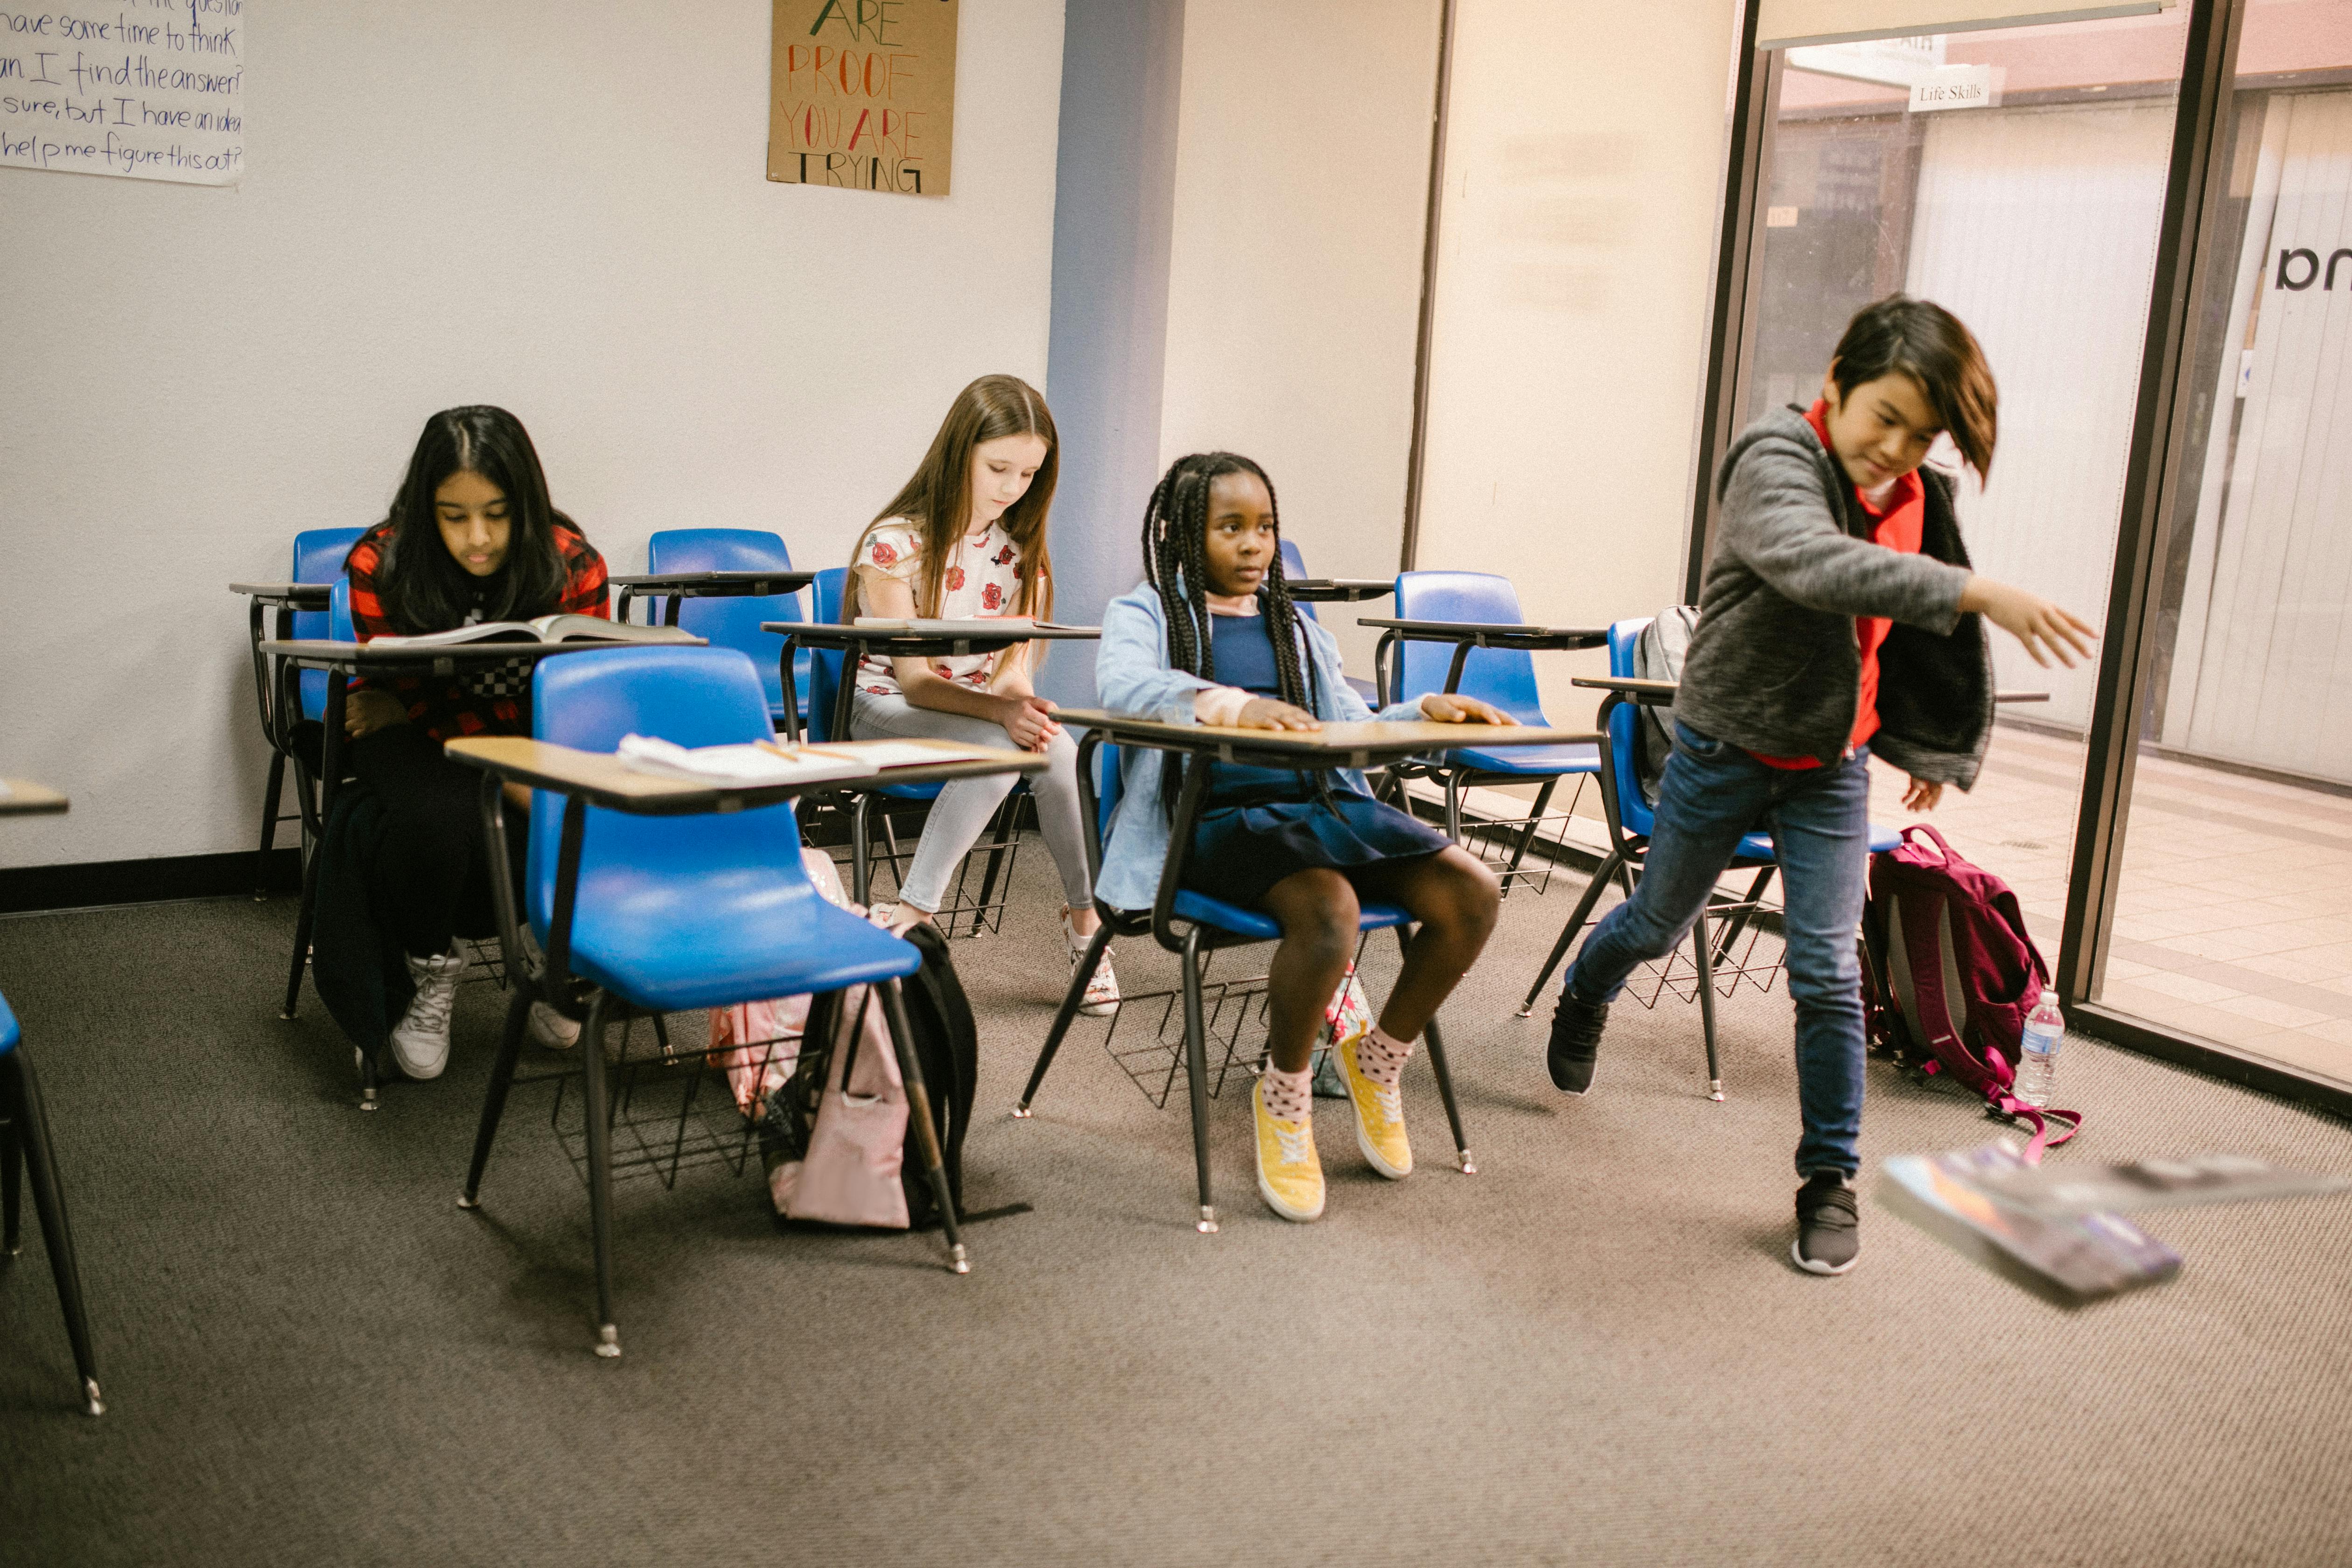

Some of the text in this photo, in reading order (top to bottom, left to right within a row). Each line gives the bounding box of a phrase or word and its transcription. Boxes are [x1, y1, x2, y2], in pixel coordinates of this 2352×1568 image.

[60, 16, 111, 40] some
[114, 13, 159, 45] time
[167, 22, 184, 51] to
[809, 0, 904, 46] ARE
[30, 53, 61, 85] I
[69, 51, 131, 96] find
[134, 55, 168, 89] the
[788, 44, 919, 100] PROOF
[1920, 84, 1981, 101] Life Skills
[65, 98, 106, 124] but
[112, 98, 136, 126] I
[142, 100, 191, 127] have
[195, 112, 212, 130] an
[217, 107, 241, 134] idea
[780, 100, 927, 160] YOU ARE
[2, 132, 60, 167] help
[65, 145, 96, 158] me
[100, 131, 164, 172] figure
[167, 145, 202, 168] this
[788, 152, 921, 193] TRYING
